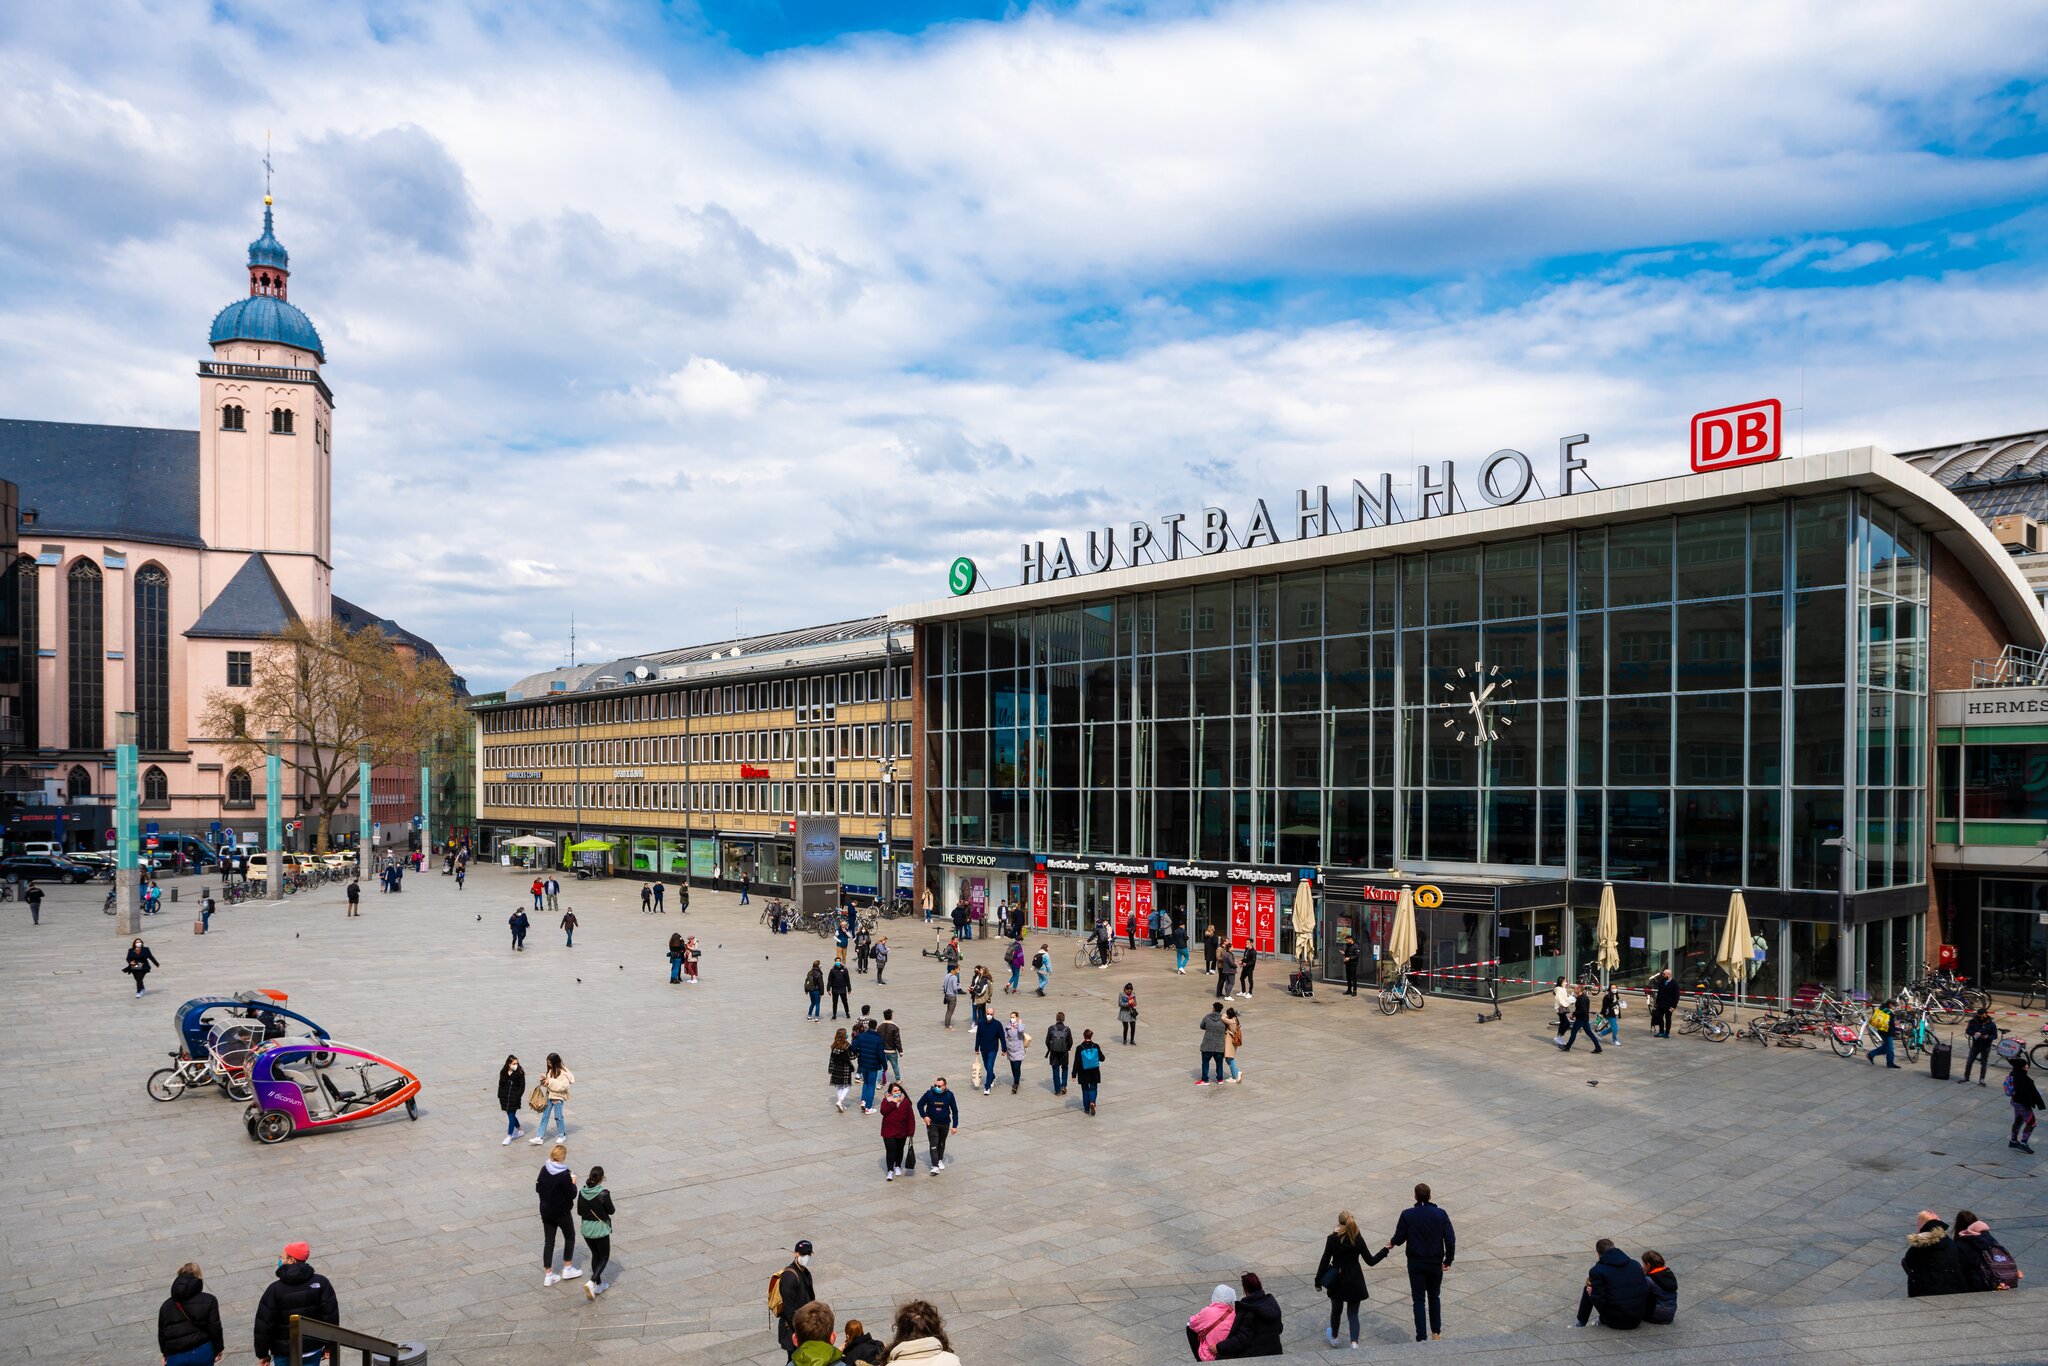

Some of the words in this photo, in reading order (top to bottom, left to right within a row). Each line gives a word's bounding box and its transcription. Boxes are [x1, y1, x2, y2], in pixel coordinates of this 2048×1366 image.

[1701, 411, 1768, 462] DB
[1020, 433, 1590, 586] HAUPTBAHNHOF
[953, 561, 969, 591] S
[844, 849, 873, 862] CHANGE
[941, 853, 955, 863] THE
[956, 854, 976, 864] BODY
[976, 855, 997, 866] SHOP
[1047, 859, 1090, 871] NetCologne
[1107, 862, 1149, 875] Highspeed
[1168, 865, 1219, 879] NetCologne
[1241, 869, 1292, 883] Highspeed
[274, 1093, 302, 1106] diconium
